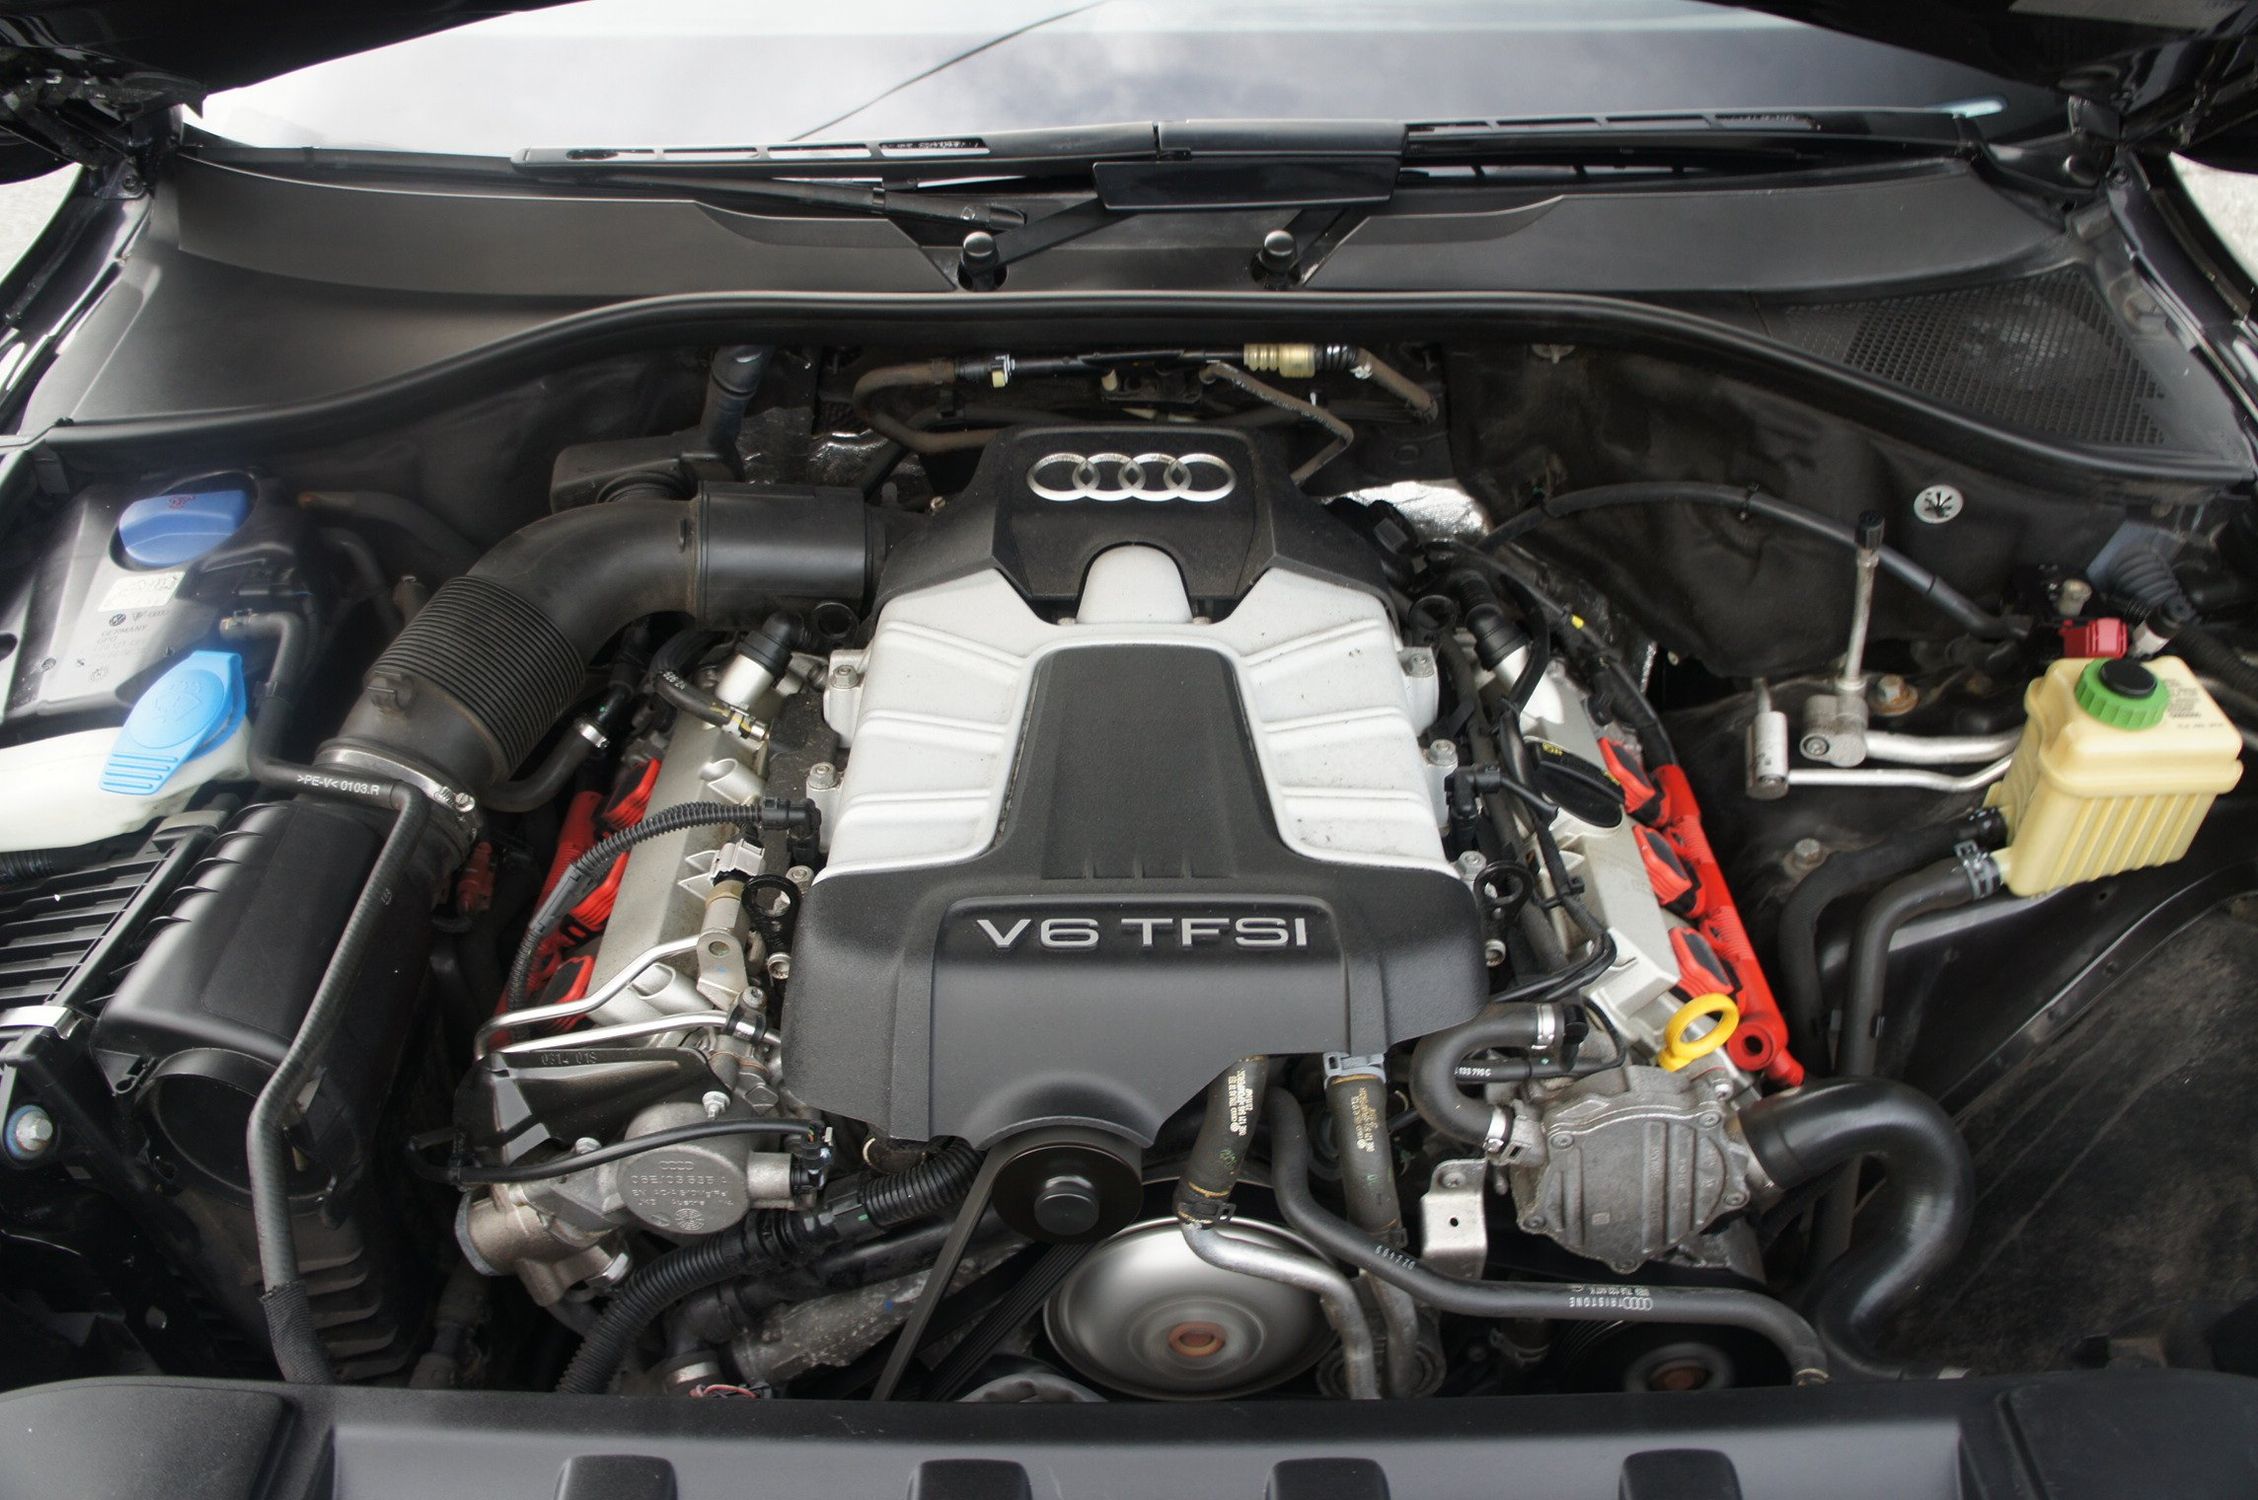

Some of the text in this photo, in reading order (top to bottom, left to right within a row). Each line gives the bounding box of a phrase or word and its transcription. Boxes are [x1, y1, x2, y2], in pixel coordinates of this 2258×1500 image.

[297, 774, 380, 796] >PE-V< 0103.R
[976, 917, 1308, 948] V6 TFSI
[1568, 1296, 1622, 1308] TRISTONE
